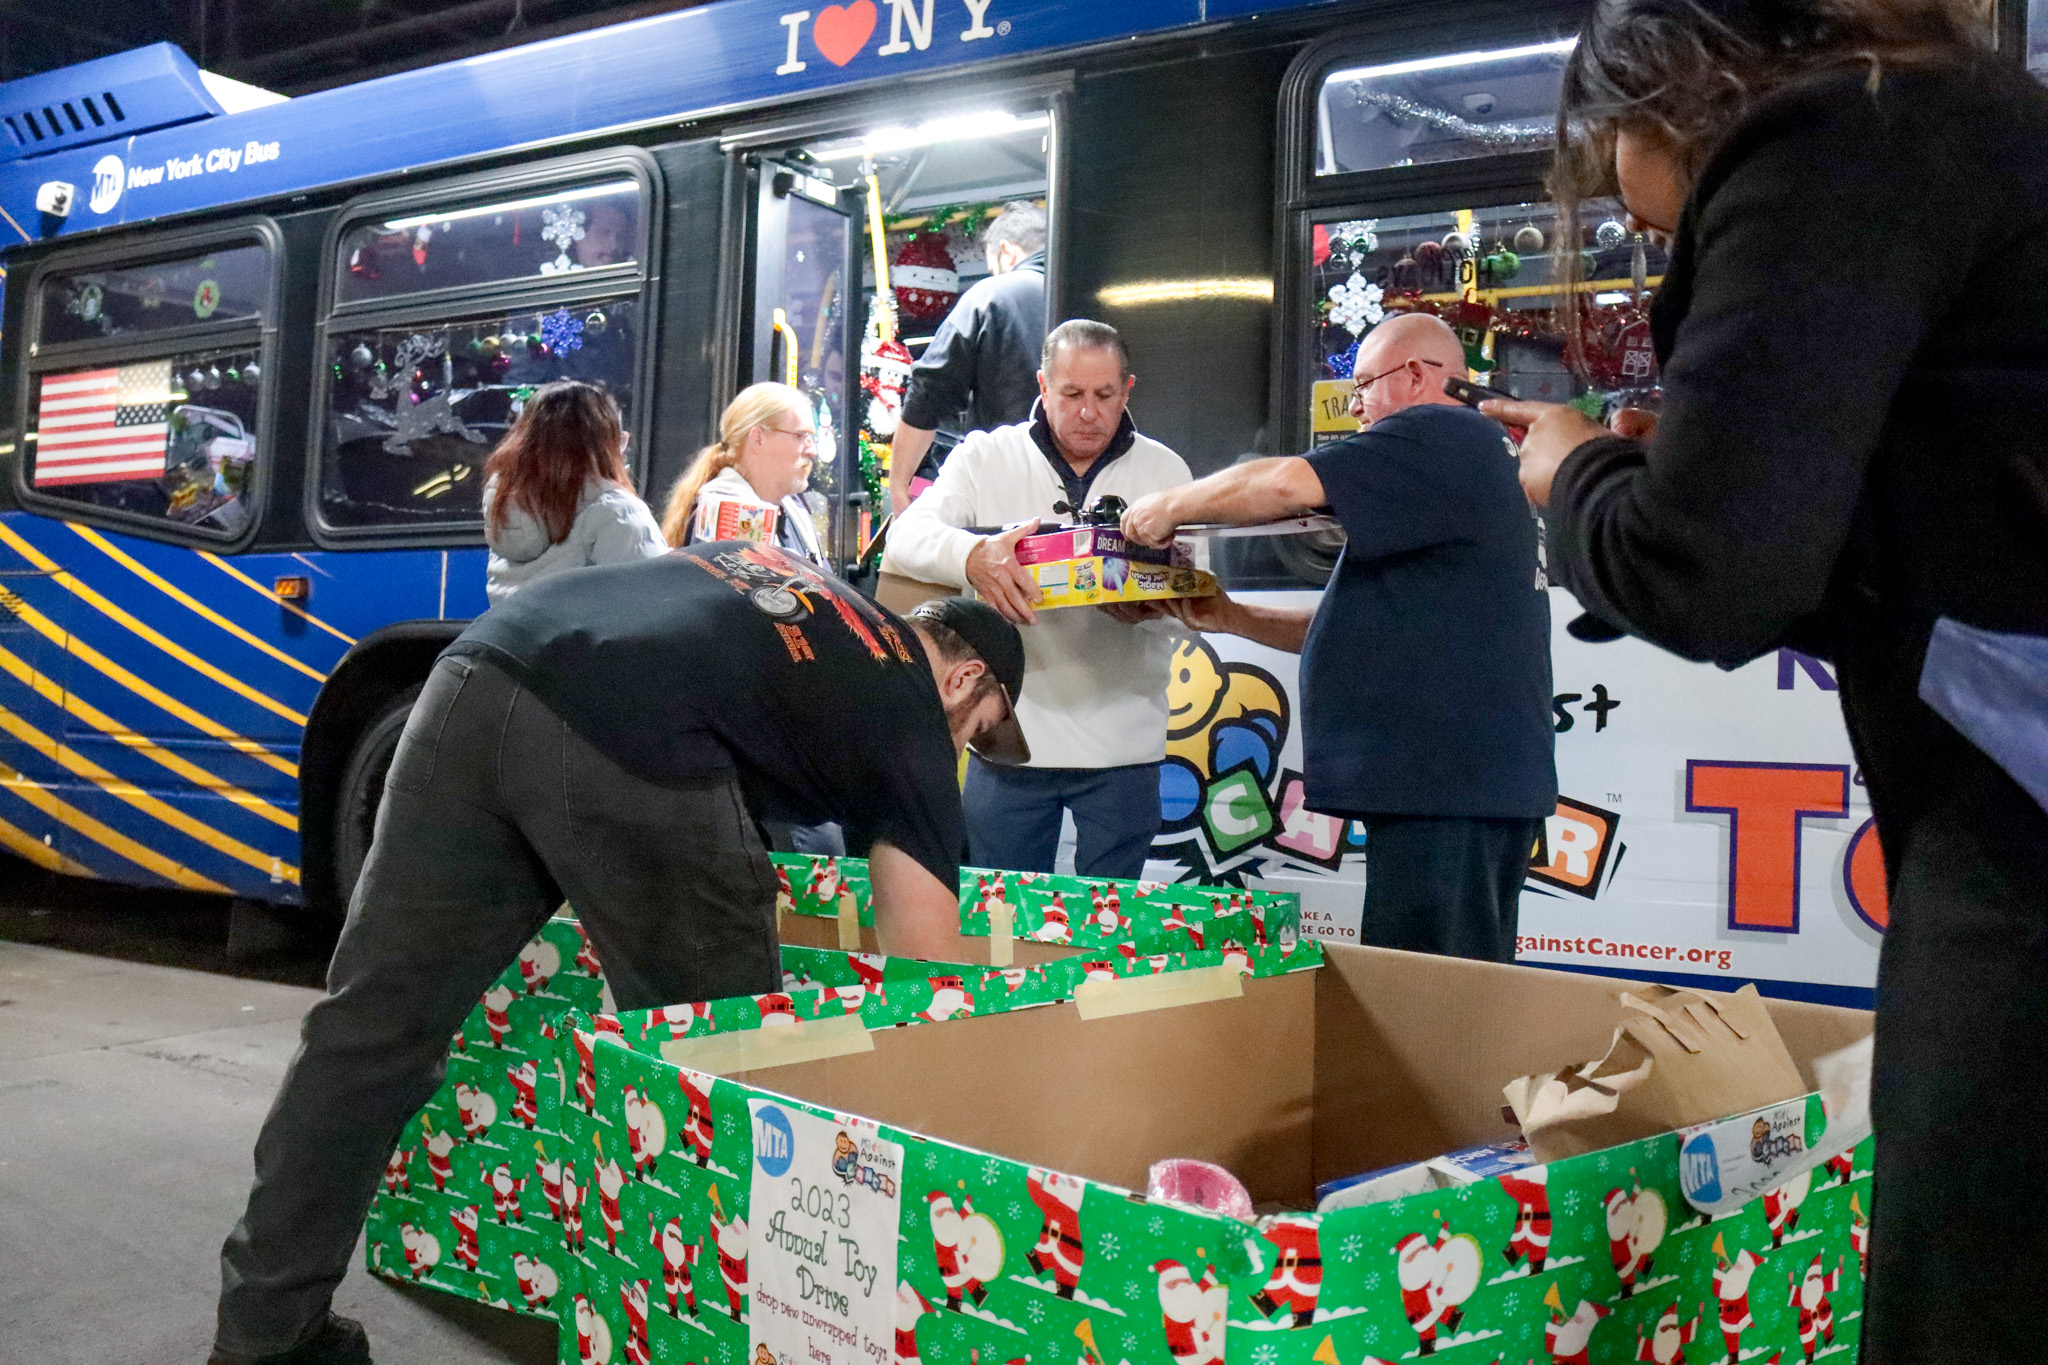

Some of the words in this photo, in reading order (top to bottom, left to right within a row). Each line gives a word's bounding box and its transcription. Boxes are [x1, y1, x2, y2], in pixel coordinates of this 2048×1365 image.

[776, 10, 811, 76] I
[127, 166, 164, 189] New
[166, 153, 204, 181] York
[205, 147, 242, 173] City
[244, 140, 280, 165] Bus
[1321, 394, 1351, 421] TRA
[1097, 536, 1126, 553] DREAM
[1137, 579, 1166, 591] Magic
[1551, 684, 1621, 733] st
[1317, 926, 1335, 936] GO
[1338, 927, 1356, 937] TO
[1324, 912, 1333, 922] A
[1515, 934, 1732, 970] gainstCancer.org
[755, 1115, 789, 1159] MTA
[1772, 1116, 1801, 1133] Against
[860, 1149, 897, 1169] Against
[791, 1177, 850, 1229] 2023
[765, 1210, 828, 1267] Annual
[838, 1233, 878, 1298] Toy
[796, 1264, 849, 1318] Drive
[756, 1282, 779, 1315] drop
[780, 1302, 800, 1320] new
[802, 1310, 859, 1348] unwrapped
[863, 1334, 888, 1364] toys
[808, 1336, 832, 1365] here
